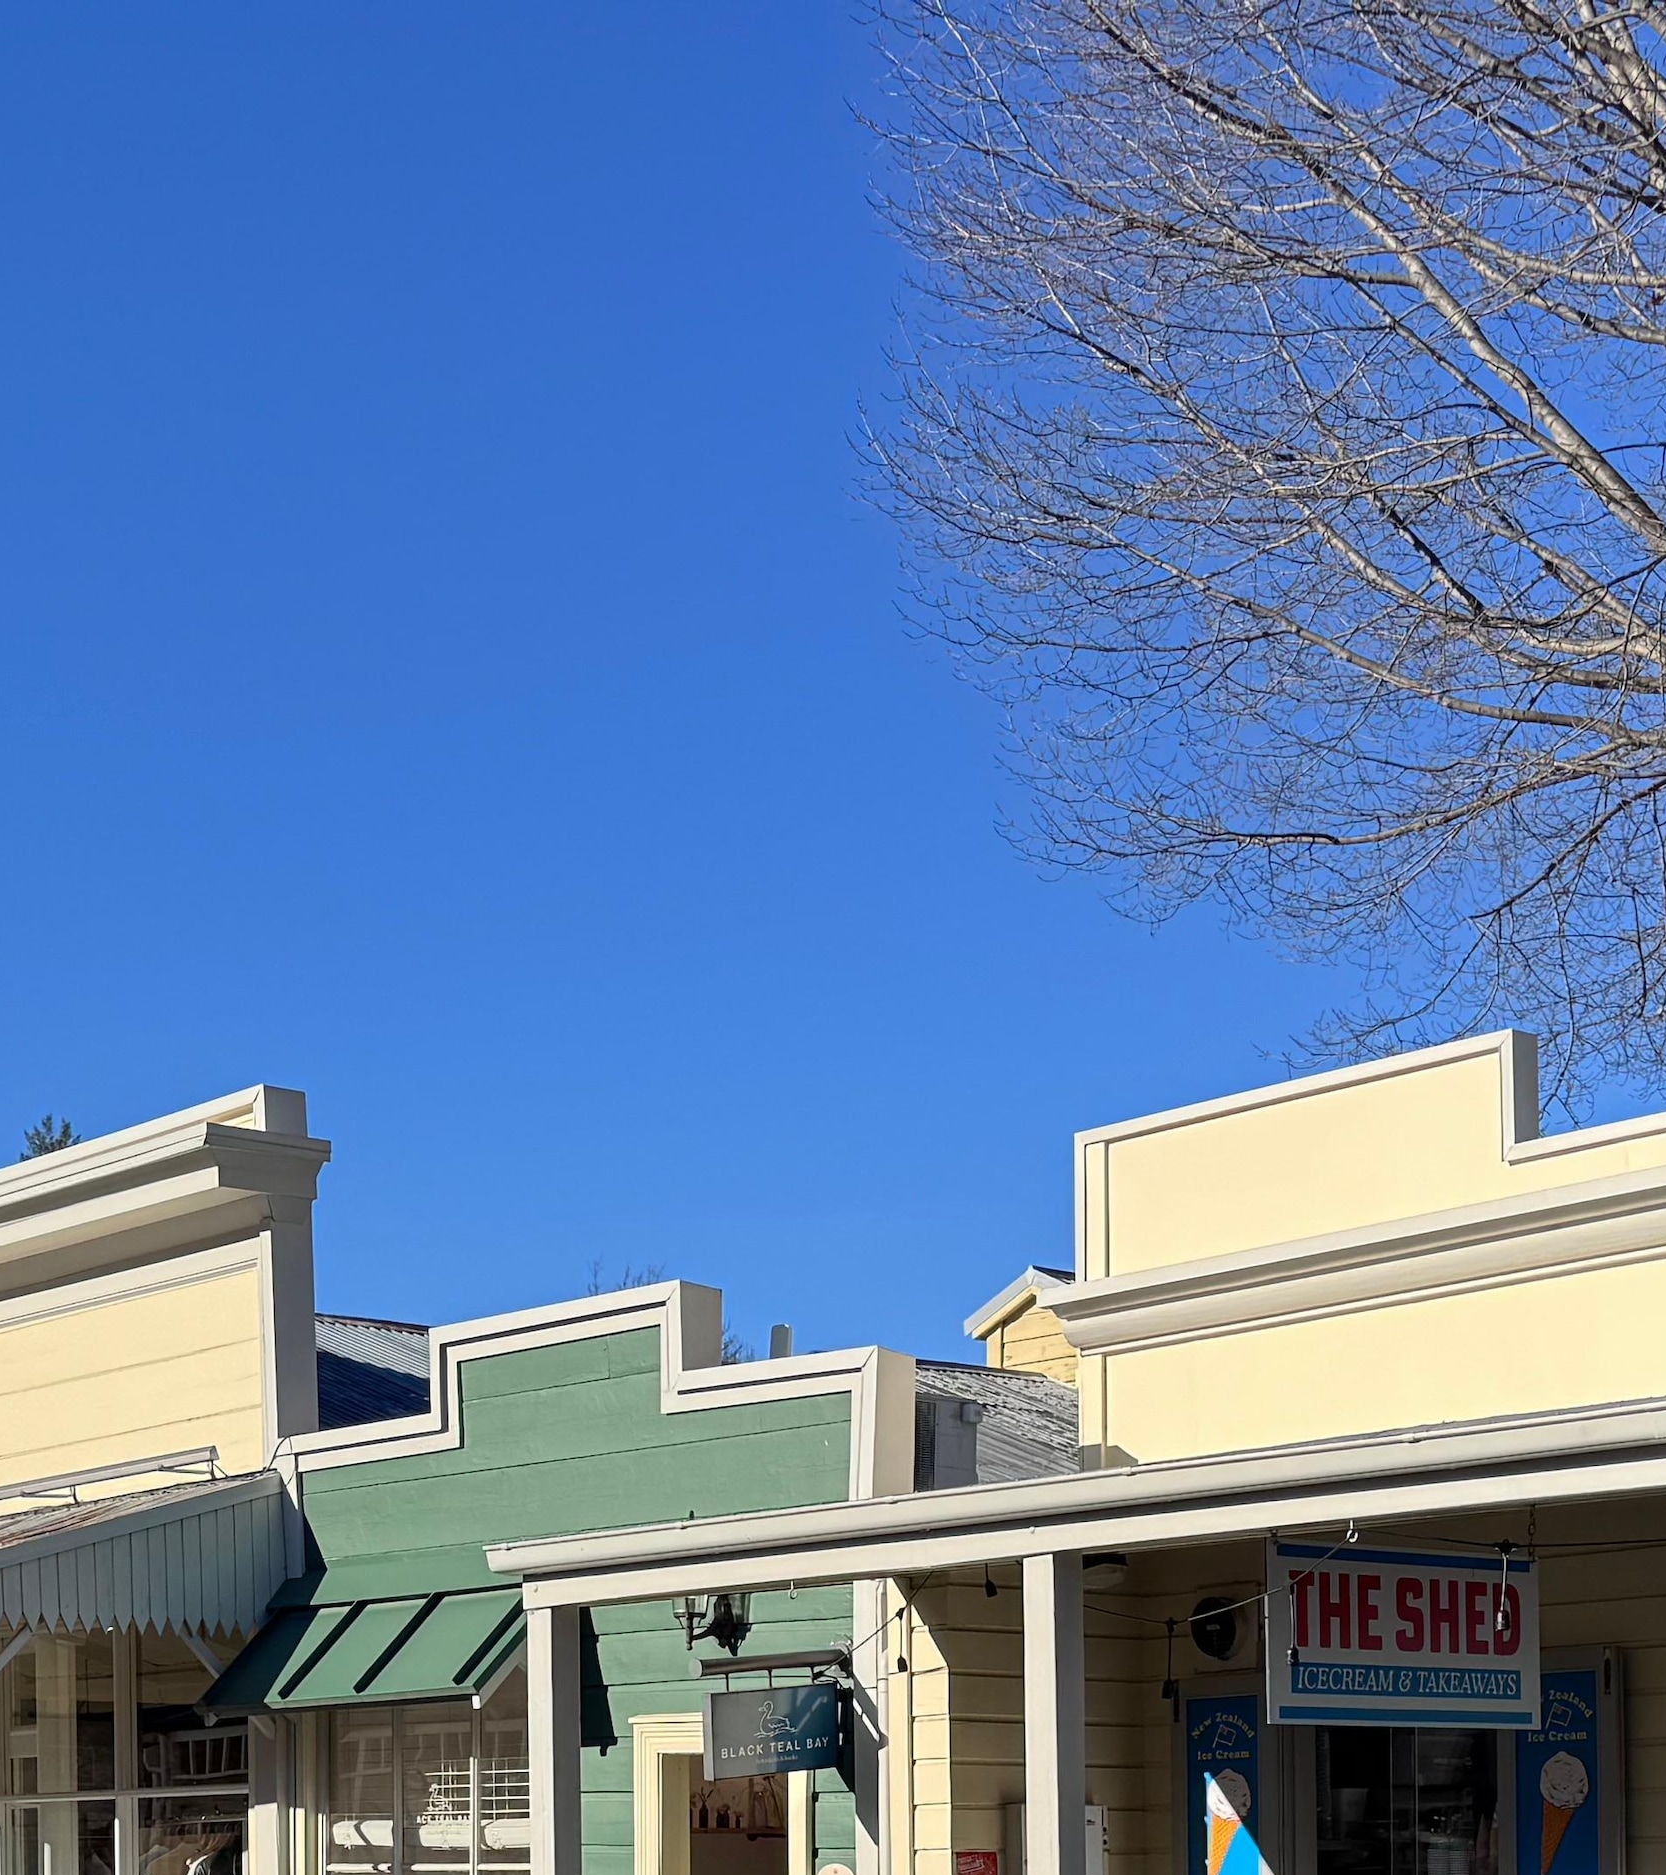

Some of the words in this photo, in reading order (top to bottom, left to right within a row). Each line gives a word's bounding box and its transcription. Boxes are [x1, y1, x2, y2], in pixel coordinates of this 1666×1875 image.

[1289, 1570, 1383, 1650] THE
[1395, 1577, 1521, 1656] SHED
[1297, 1666, 1394, 1691] ICECREAM
[1398, 1669, 1414, 1692] &
[1418, 1670, 1518, 1696] TAKEAWAYS
[1548, 1690, 1593, 1718] Zealand
[1191, 1716, 1212, 1740] New
[1215, 1711, 1255, 1739] Zealand
[1527, 1732, 1545, 1743] Ice
[1548, 1731, 1588, 1741] Cream
[721, 1743, 764, 1760] BLACK
[769, 1739, 801, 1754] TEAL
[806, 1736, 829, 1750] BAY
[1197, 1750, 1213, 1761] Ice
[1215, 1750, 1250, 1760] Cream
